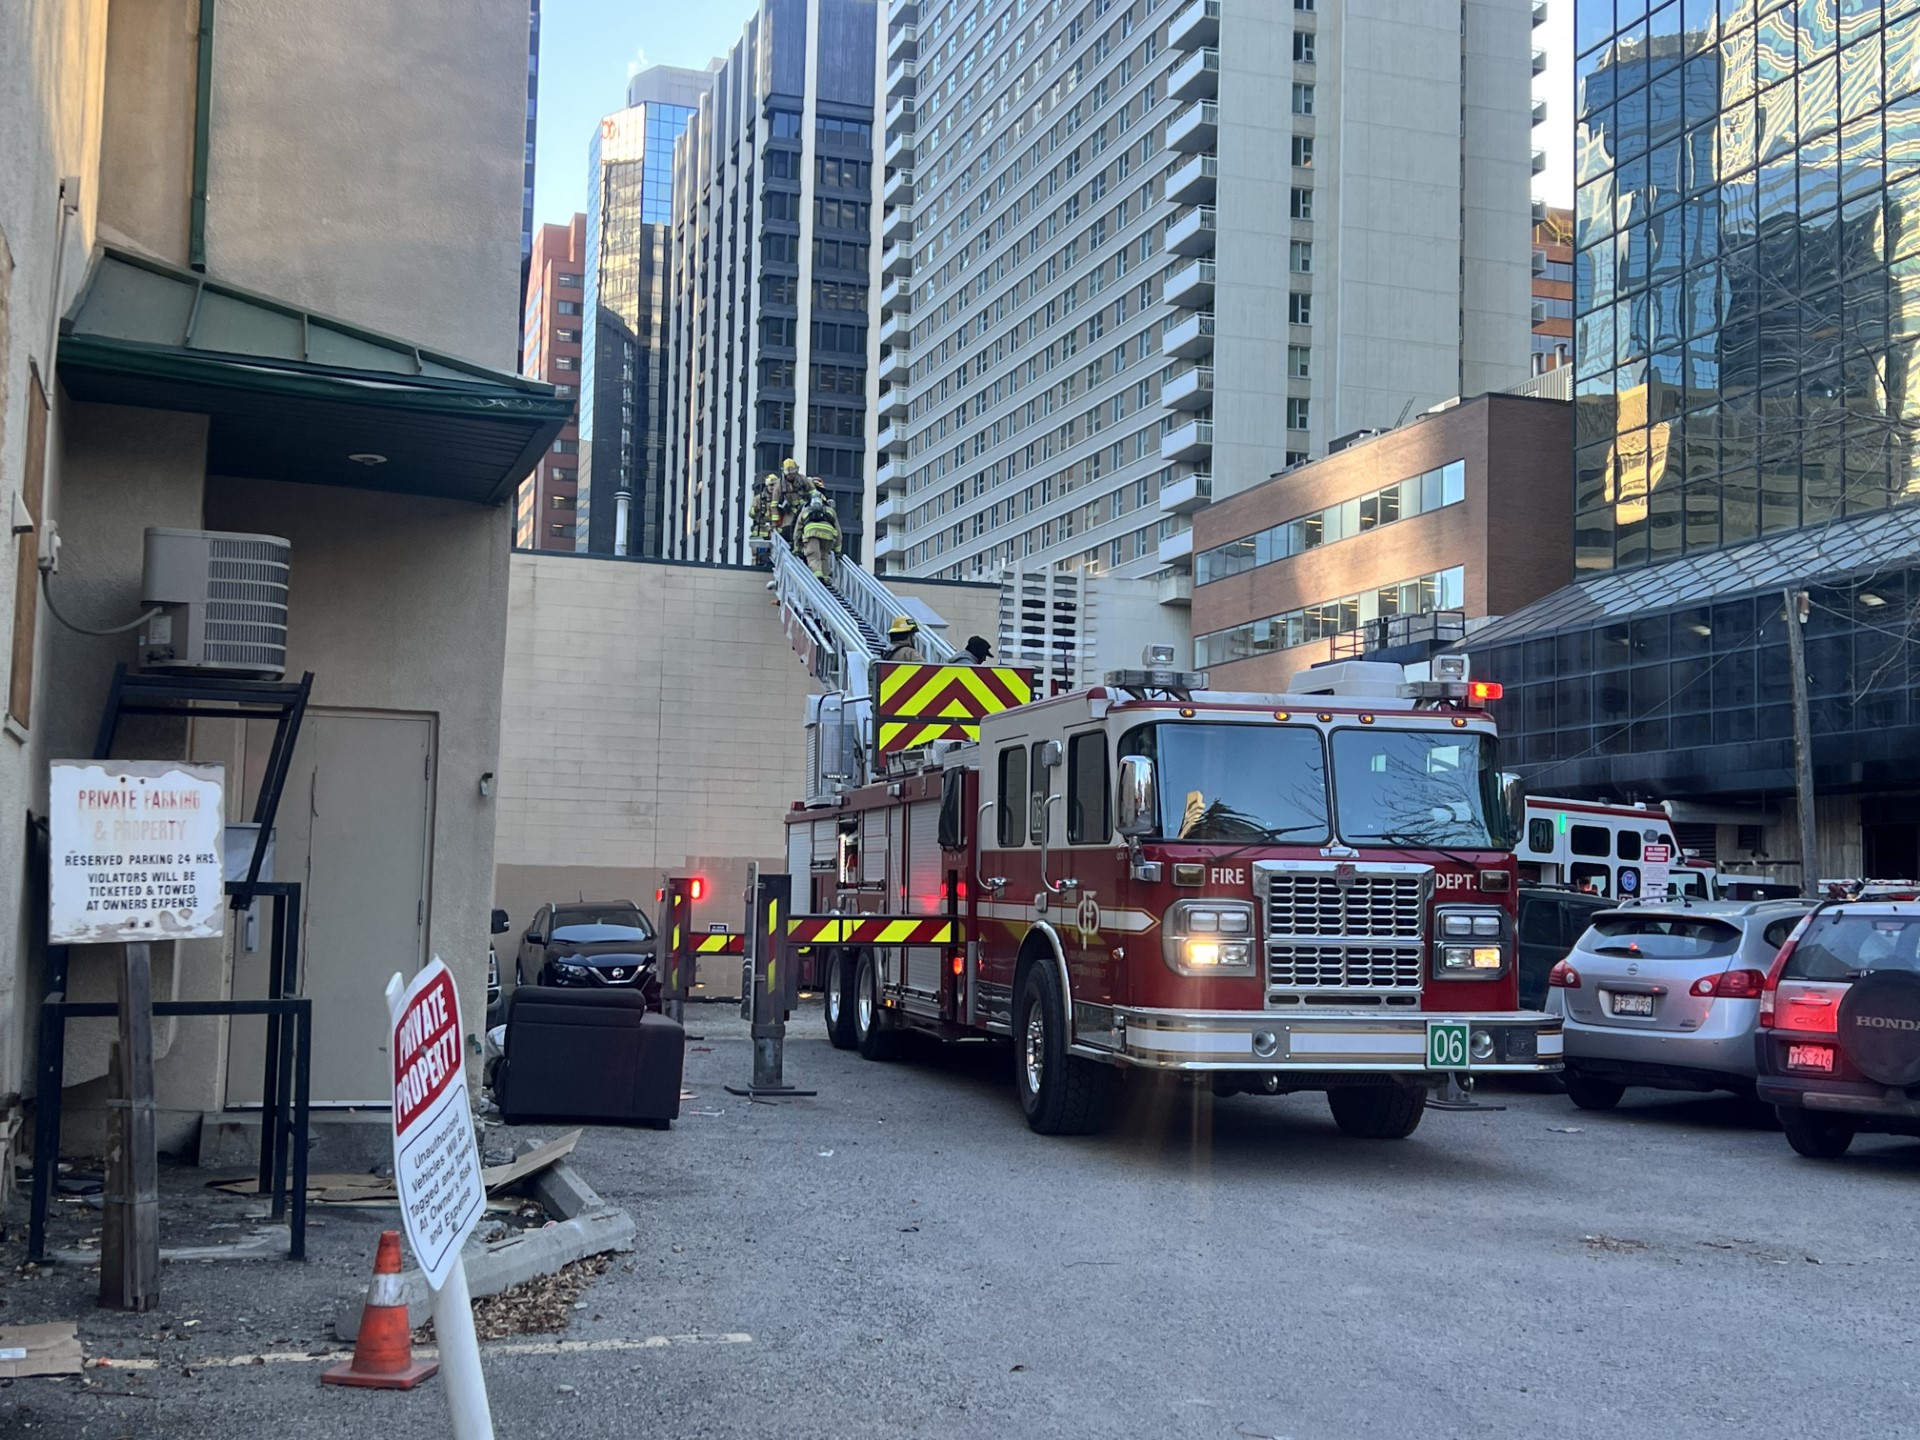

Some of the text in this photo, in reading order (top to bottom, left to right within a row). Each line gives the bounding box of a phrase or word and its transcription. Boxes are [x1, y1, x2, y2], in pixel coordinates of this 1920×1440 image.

[78, 789, 201, 810] PRIVATE PARKING
[113, 819, 187, 841] PROPERTY
[64, 855, 123, 867] RESERVED
[128, 854, 173, 865] PARKING
[177, 854, 191, 864] 24
[88, 871, 196, 884] VIOLATORS WILL BE
[89, 885, 196, 897] TICKETED & TOWED
[1210, 868, 1245, 885] FIRE
[1434, 873, 1478, 891] DEPT.
[86, 897, 198, 911] AT OWNERS EXPENSE
[399, 983, 449, 1069] PRIVATE
[1432, 1028, 1464, 1064] 06
[396, 1023, 457, 1124] PROPERTY
[414, 1109, 460, 1169] Unauthorized
[411, 1125, 466, 1195] Vehicles Will Be
[409, 1138, 473, 1219] Tagged and Towed
[419, 1161, 473, 1235] At Owner's Risk
[429, 1186, 471, 1245] and Expense
